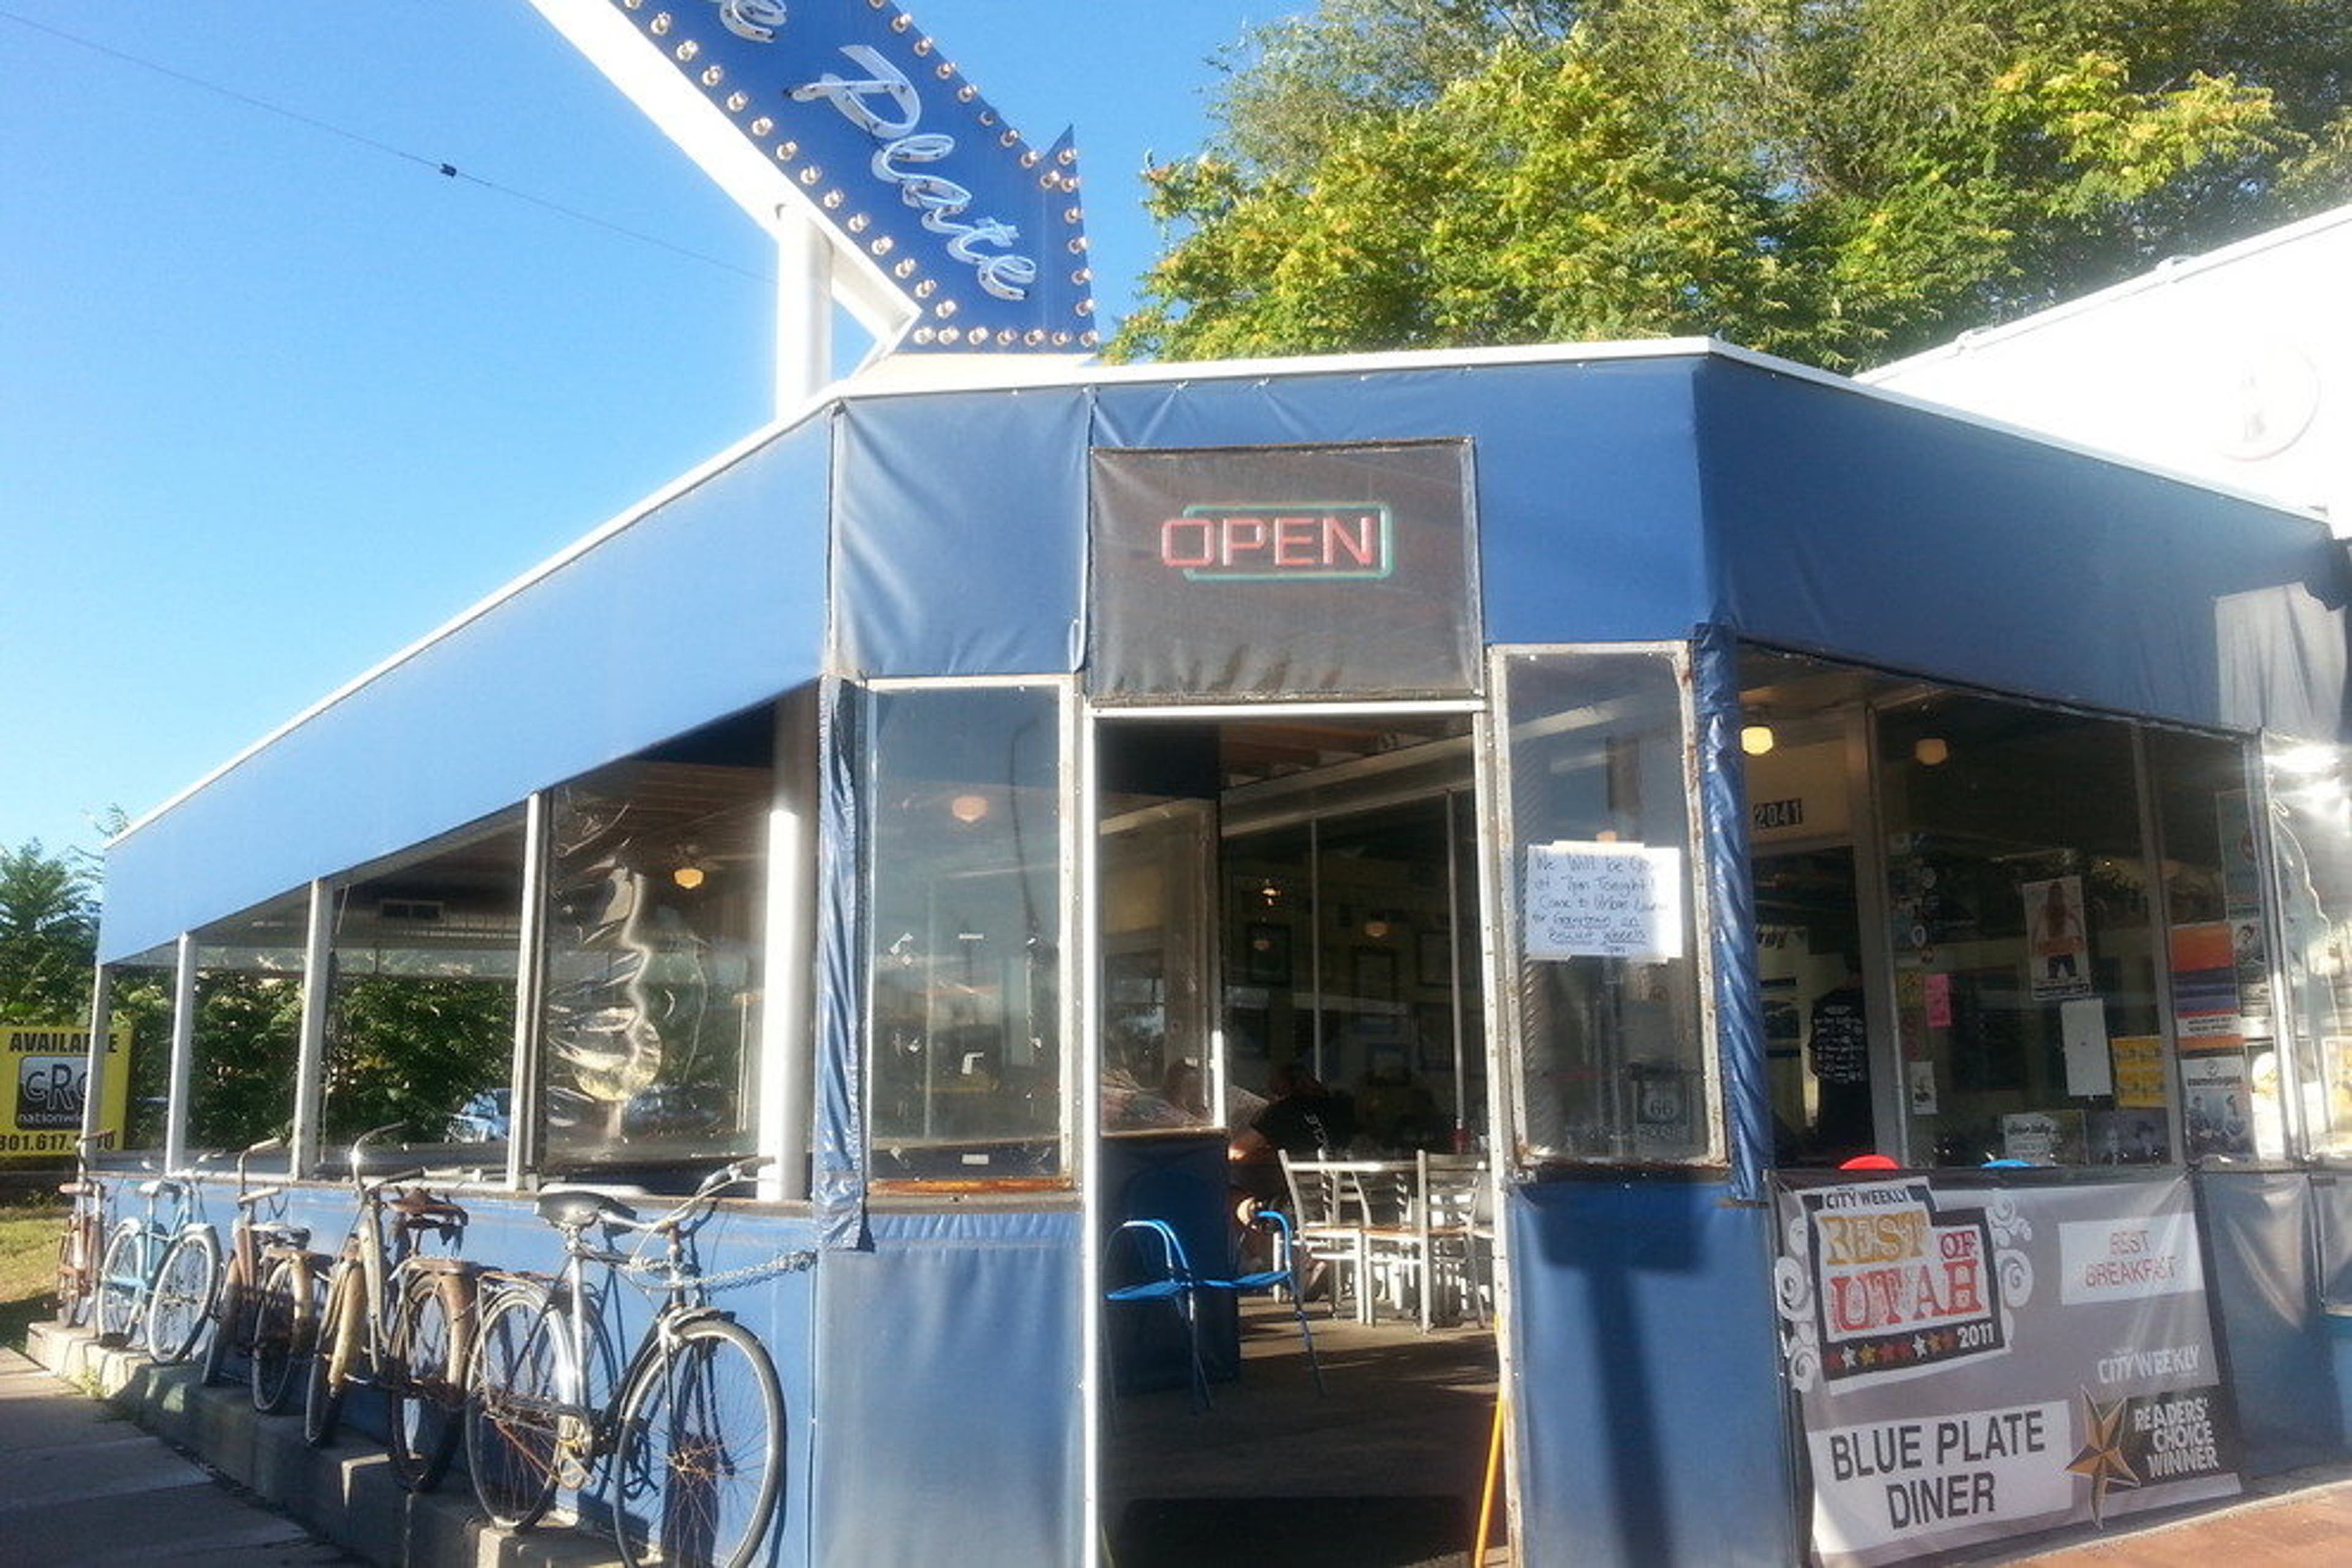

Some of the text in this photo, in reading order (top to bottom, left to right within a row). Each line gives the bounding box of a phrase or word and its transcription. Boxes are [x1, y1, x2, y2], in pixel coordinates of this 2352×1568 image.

[785, 44, 1037, 300] Plate
[1161, 516, 1374, 567] OPEN
[1755, 802, 1799, 827] 2041
[9, 1033, 118, 1052] AVAILAE
[1826, 1188, 1907, 1208] CITY WEEKLY
[1939, 1231, 1977, 1259] OF
[2110, 1231, 2150, 1254] BEST
[2086, 1256, 2176, 1287] BREAKFST
[1830, 1259, 1981, 1332] UTAH
[1958, 1323, 1994, 1347] 2011
[2097, 1345, 2199, 1383] CITY WEEKLY
[1830, 1410, 2046, 1481] BLUE PLATE
[2152, 1421, 2214, 1452] CHOICE
[2147, 1447, 2219, 1477] WINNER
[1886, 1471, 1996, 1529] DINER
